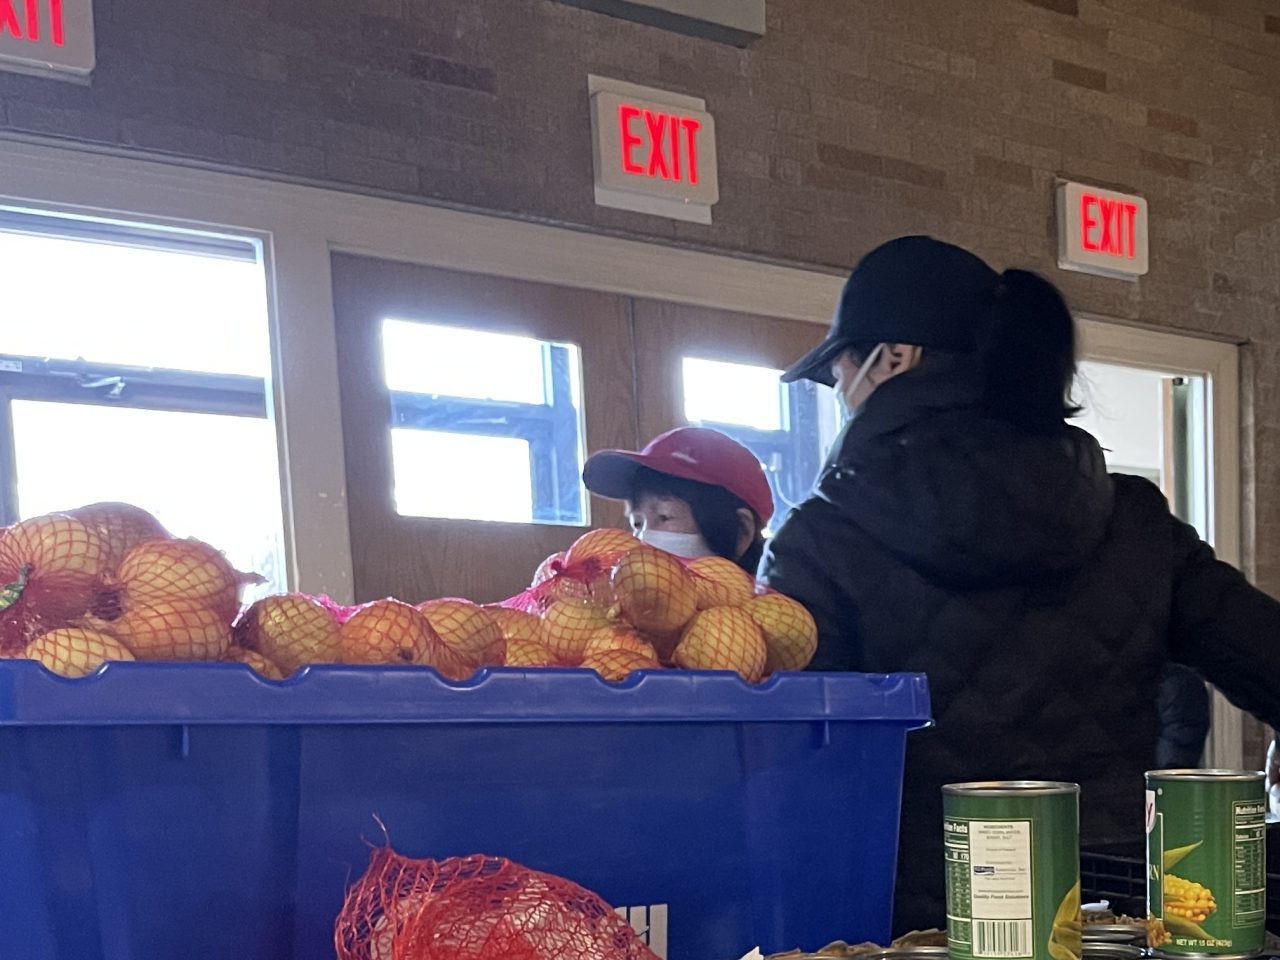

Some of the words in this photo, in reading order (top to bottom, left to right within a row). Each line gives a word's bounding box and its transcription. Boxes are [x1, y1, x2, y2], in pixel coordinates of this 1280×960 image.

[0, 0, 64, 48] XIT
[619, 103, 701, 185] EXIT
[1081, 193, 1137, 260] EXIT
[1176, 938, 1187, 946] NET
